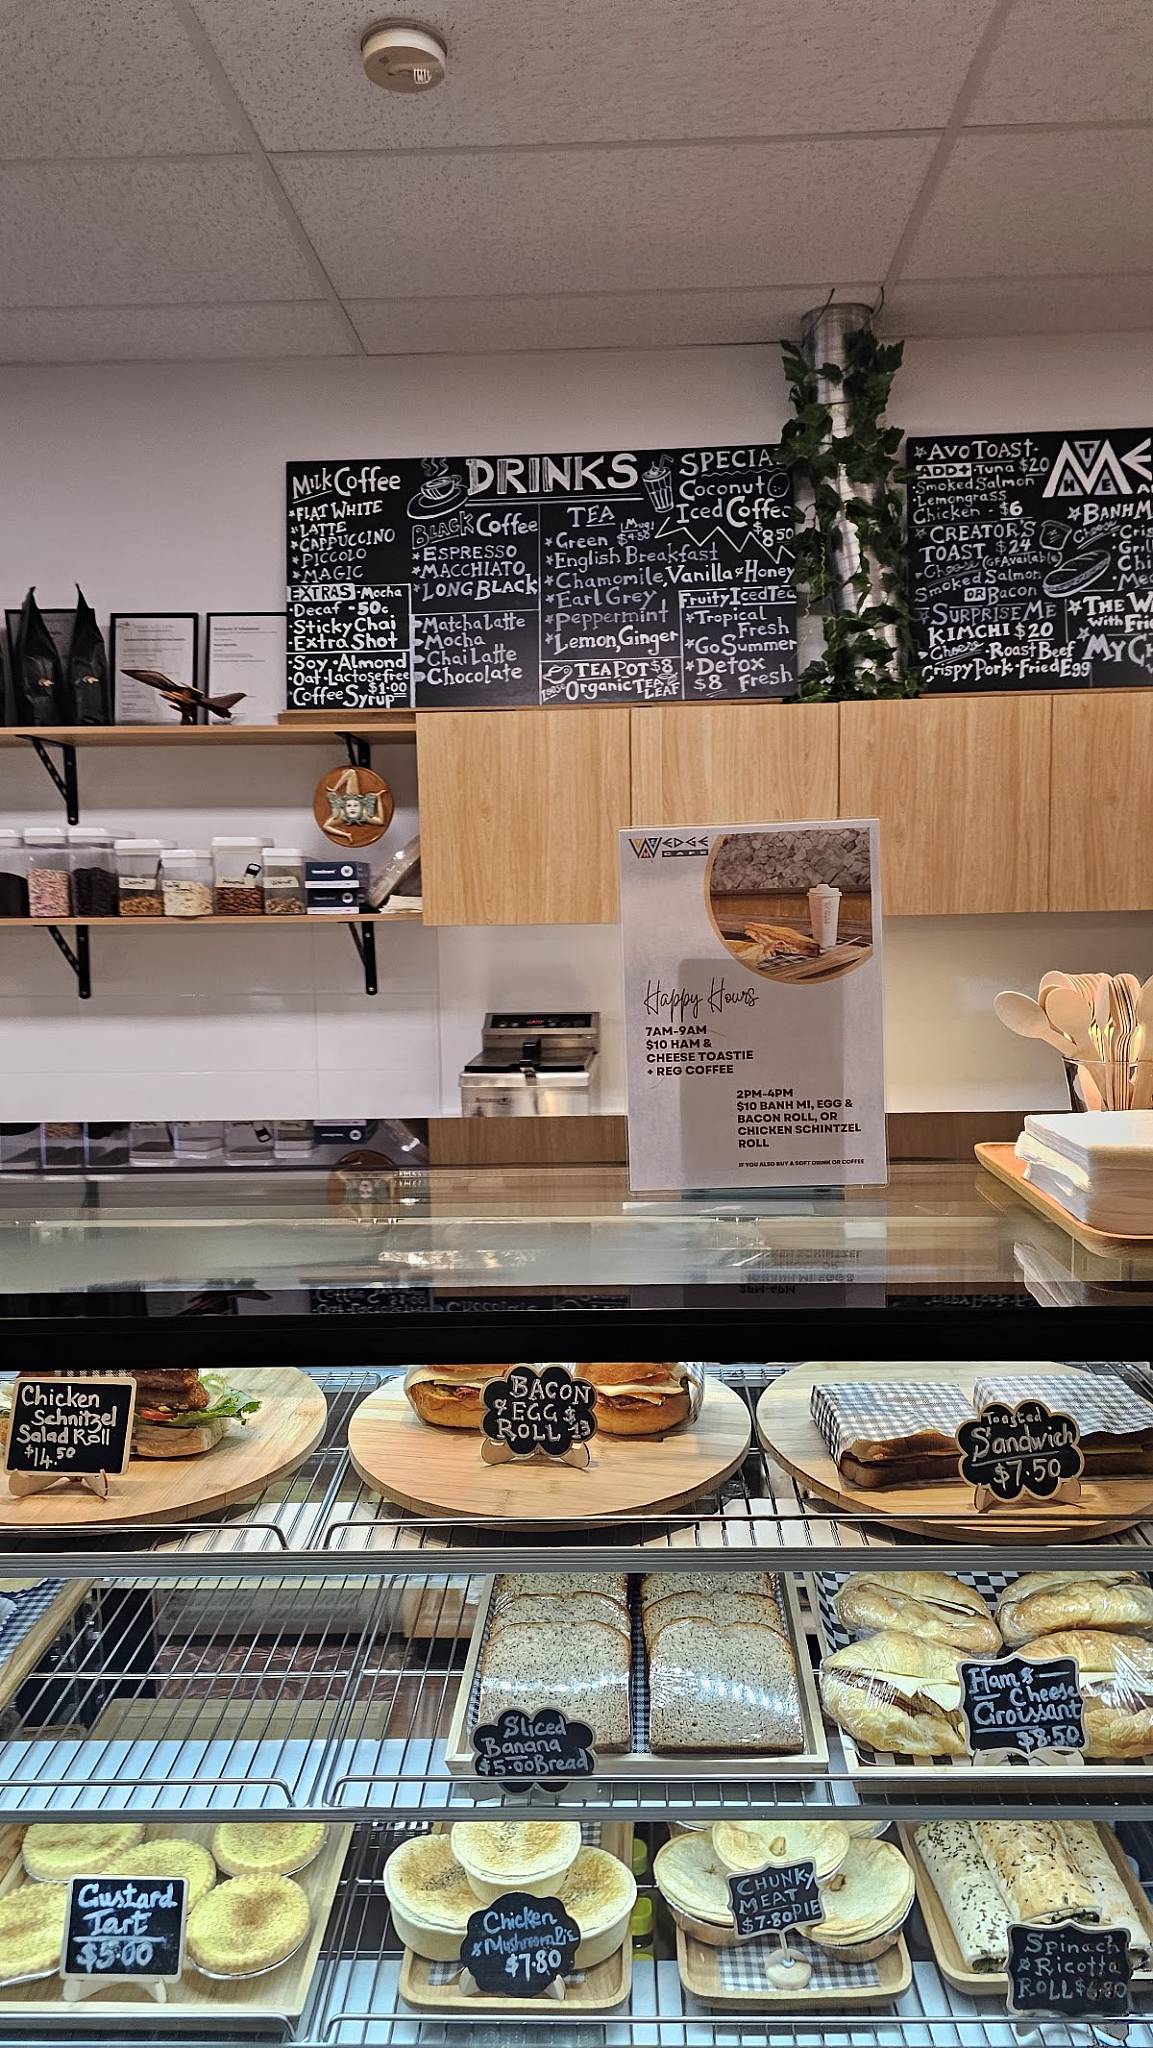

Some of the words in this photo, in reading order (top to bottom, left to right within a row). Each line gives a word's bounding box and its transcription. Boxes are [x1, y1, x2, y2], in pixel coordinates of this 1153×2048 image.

[465, 453, 638, 496] DRINKS
[976, 464, 1015, 475] Tuna
[1019, 457, 1050, 473] $20
[334, 466, 401, 497] Coffee
[679, 475, 765, 501] Coconut
[916, 477, 973, 495] Smoked
[975, 474, 1035, 491] Salmon
[296, 504, 328, 521] FLAT
[330, 500, 383, 519] WHITE
[675, 498, 723, 524] Iced
[917, 490, 1008, 508] Lemongrass
[566, 504, 615, 528] TEA
[913, 504, 980, 525] Chicken
[999, 500, 1023, 516] $6
[299, 521, 347, 538] LATTE
[299, 528, 396, 552] CAPPUCCINO
[411, 510, 475, 551] BLACK
[476, 512, 539, 536] Coffee
[555, 531, 608, 549] Green
[929, 520, 1037, 544] CREATOR'S
[300, 548, 367, 569] PICCOLO
[423, 545, 518, 561] ESPRESSO
[554, 547, 621, 573] English
[624, 541, 719, 566] Breakfast
[918, 543, 986, 563] TOAST
[995, 538, 1031, 555] $24
[300, 565, 364, 583] MAGIC
[419, 561, 526, 579] MACCHIATO
[664, 562, 733, 584] Vanilla
[744, 559, 795, 584] Honey
[292, 584, 353, 601] EXTRAS
[360, 585, 402, 600] Mocha
[421, 580, 474, 602] LONG
[680, 590, 730, 608] Fruity
[729, 586, 767, 605] Iced
[767, 585, 797, 602] Tea
[914, 572, 982, 602] Smoked
[984, 569, 1042, 584] Salmon
[987, 586, 1037, 606] Bacon
[293, 601, 342, 617] Decaf
[556, 588, 603, 609] Earl
[605, 585, 658, 611] Grey
[1082, 595, 1125, 616] THE
[422, 613, 483, 633] Matcha
[555, 598, 669, 632] Peppermint
[693, 604, 767, 628] Tropical
[930, 602, 1022, 626] SURPRISE
[1020, 599, 1057, 622] ME
[293, 617, 353, 638] Sticky
[354, 614, 397, 633] Chai
[737, 616, 790, 638] Fresh
[927, 622, 1010, 649] KIMCHI
[1013, 621, 1054, 641] $20
[293, 633, 349, 651] Extra
[350, 630, 398, 650] Shot
[424, 632, 486, 650] Mocha
[618, 624, 679, 656] Ginger
[720, 633, 798, 656] Summer
[988, 641, 1037, 660] Roast
[1038, 641, 1077, 660] Beef
[293, 655, 328, 673] Soy
[337, 651, 408, 672] Almond
[426, 649, 468, 667] Chai
[695, 656, 767, 676] Detox
[921, 662, 973, 682] Crispy
[972, 657, 1014, 680] Pork
[1018, 657, 1060, 679] Fried
[1060, 658, 1093, 678] Egg
[293, 668, 321, 686] Oat
[426, 663, 523, 686] Chocolate
[738, 663, 794, 693] Fresh
[292, 686, 344, 706] Coffee
[342, 683, 394, 709] Syrup
[565, 679, 633, 700] Organic
[643, 979, 703, 1023] Happy
[708, 977, 760, 1013] Hours
[645, 1025, 707, 1037] 7AM-9AM
[646, 1039, 668, 1051] $10
[670, 1038, 700, 1049] HAM
[702, 1038, 712, 1048] &
[646, 1052, 696, 1063] CHEESE
[697, 1050, 754, 1062] TOASTIE
[656, 1066, 682, 1076] REG
[685, 1064, 734, 1075] COFFEE
[736, 1088, 794, 1099] 2PM-4PM
[736, 1101, 757, 1112] $10
[760, 1100, 794, 1110] BANH
[816, 1098, 843, 1109] EGG
[844, 1098, 854, 1108] &
[737, 1113, 781, 1124] BACON
[783, 1111, 818, 1123] ROLL,
[820, 1111, 838, 1121] OR
[737, 1125, 793, 1136] CHICKEN
[794, 1123, 862, 1134] SCHINTZEL
[738, 1138, 770, 1149] ROLL
[21, 1384, 100, 1408] Chicken
[509, 1374, 592, 1405] BACON
[31, 1405, 118, 1434] Schnitzel
[511, 1401, 558, 1423] EGG
[16, 1423, 69, 1445] Salad
[73, 1428, 110, 1447] Roll
[496, 1417, 561, 1442] ROLL
[970, 1422, 1074, 1462] Sandwich
[992, 1458, 1062, 1492] $7.50
[967, 1666, 1020, 1694] Ham
[1009, 1682, 1080, 1707] Cheese
[973, 1698, 1082, 1726] Croissant
[503, 1715, 567, 1739] Sliced
[480, 1737, 562, 1758] Banana
[533, 1747, 589, 1775] Bread
[736, 1867, 815, 1896] CHUNKY
[78, 1882, 178, 1910] Custard
[739, 1888, 799, 1915] MEAT
[82, 1907, 153, 1936] Tart
[483, 1905, 558, 1934] Chicken
[791, 1899, 821, 1921] PIE
[1024, 1933, 1121, 1956] Spinach
[504, 1948, 562, 1982] $7.80
[1034, 1955, 1121, 1977] Ricotta
[1017, 1977, 1074, 2001] ROLL
